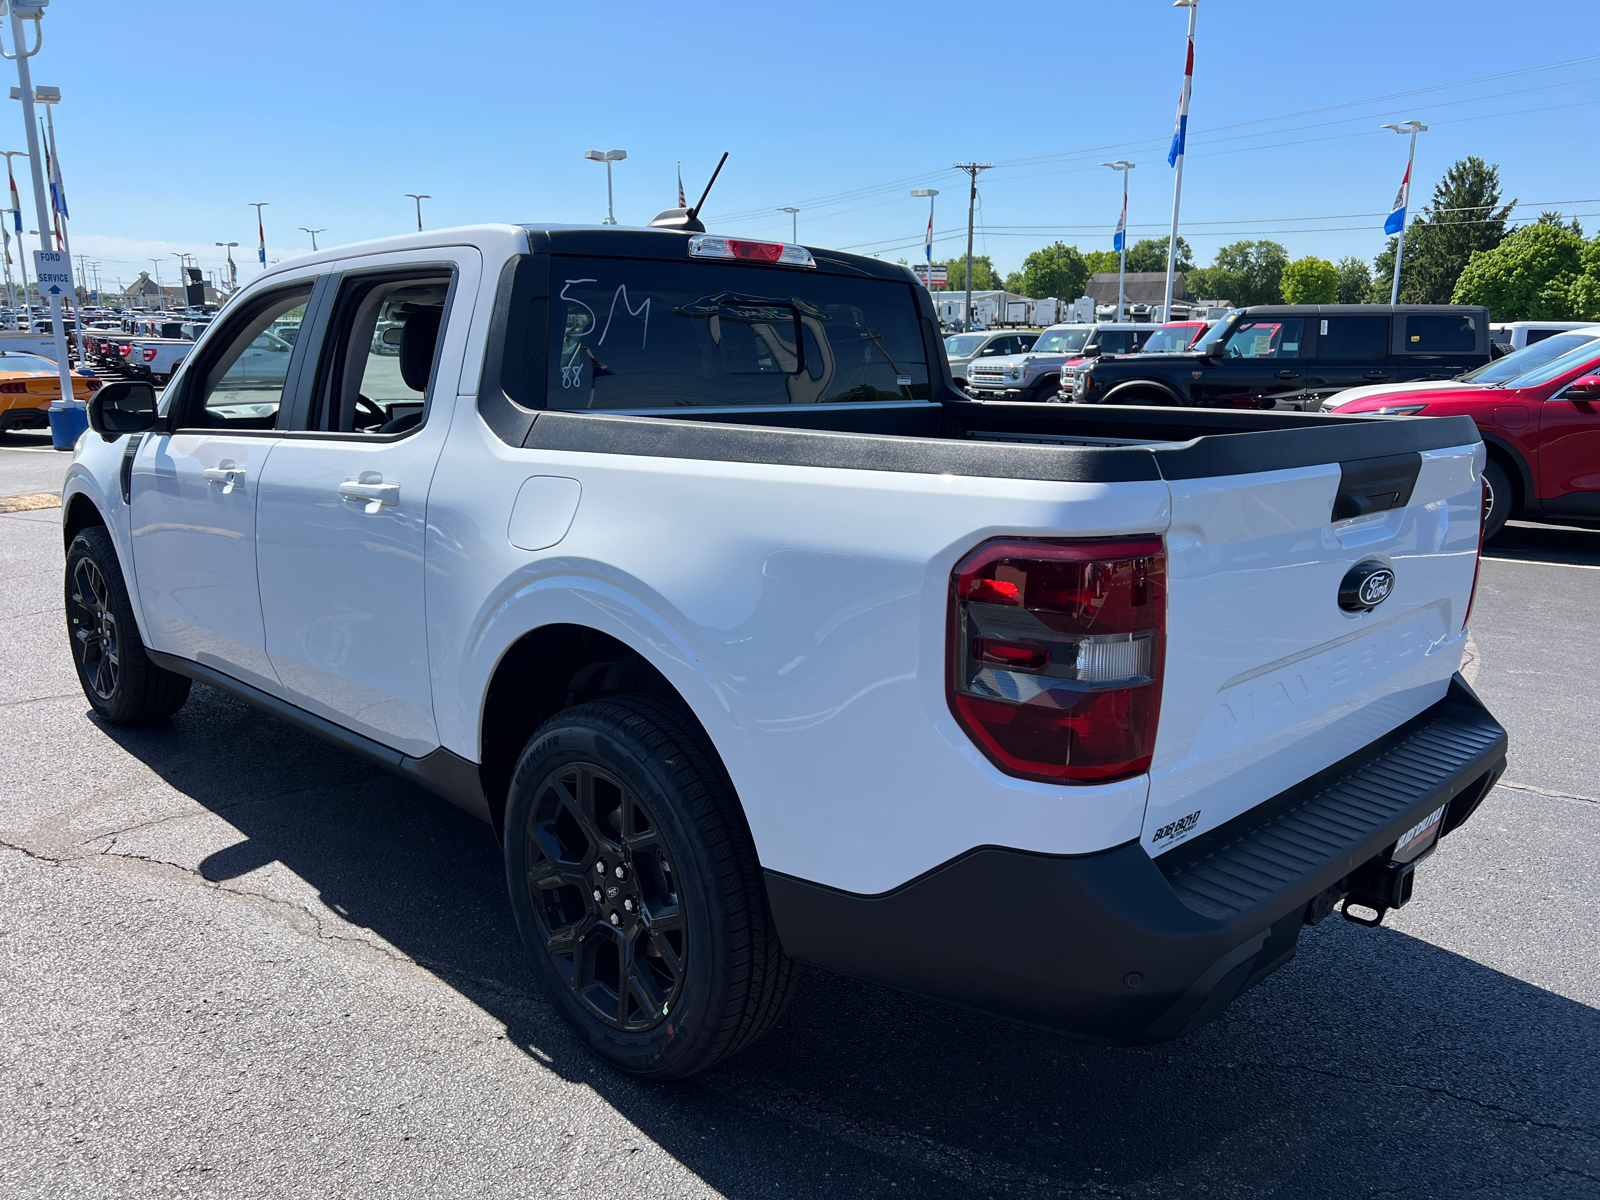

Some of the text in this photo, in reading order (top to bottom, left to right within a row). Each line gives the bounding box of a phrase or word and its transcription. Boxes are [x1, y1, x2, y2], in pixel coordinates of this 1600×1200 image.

[40, 252, 61, 262] FORD
[38, 273, 69, 283] SERVICE
[561, 362, 584, 389] 88
[1365, 575, 1392, 601] Ford
[514, 735, 560, 786] WRANGLER
